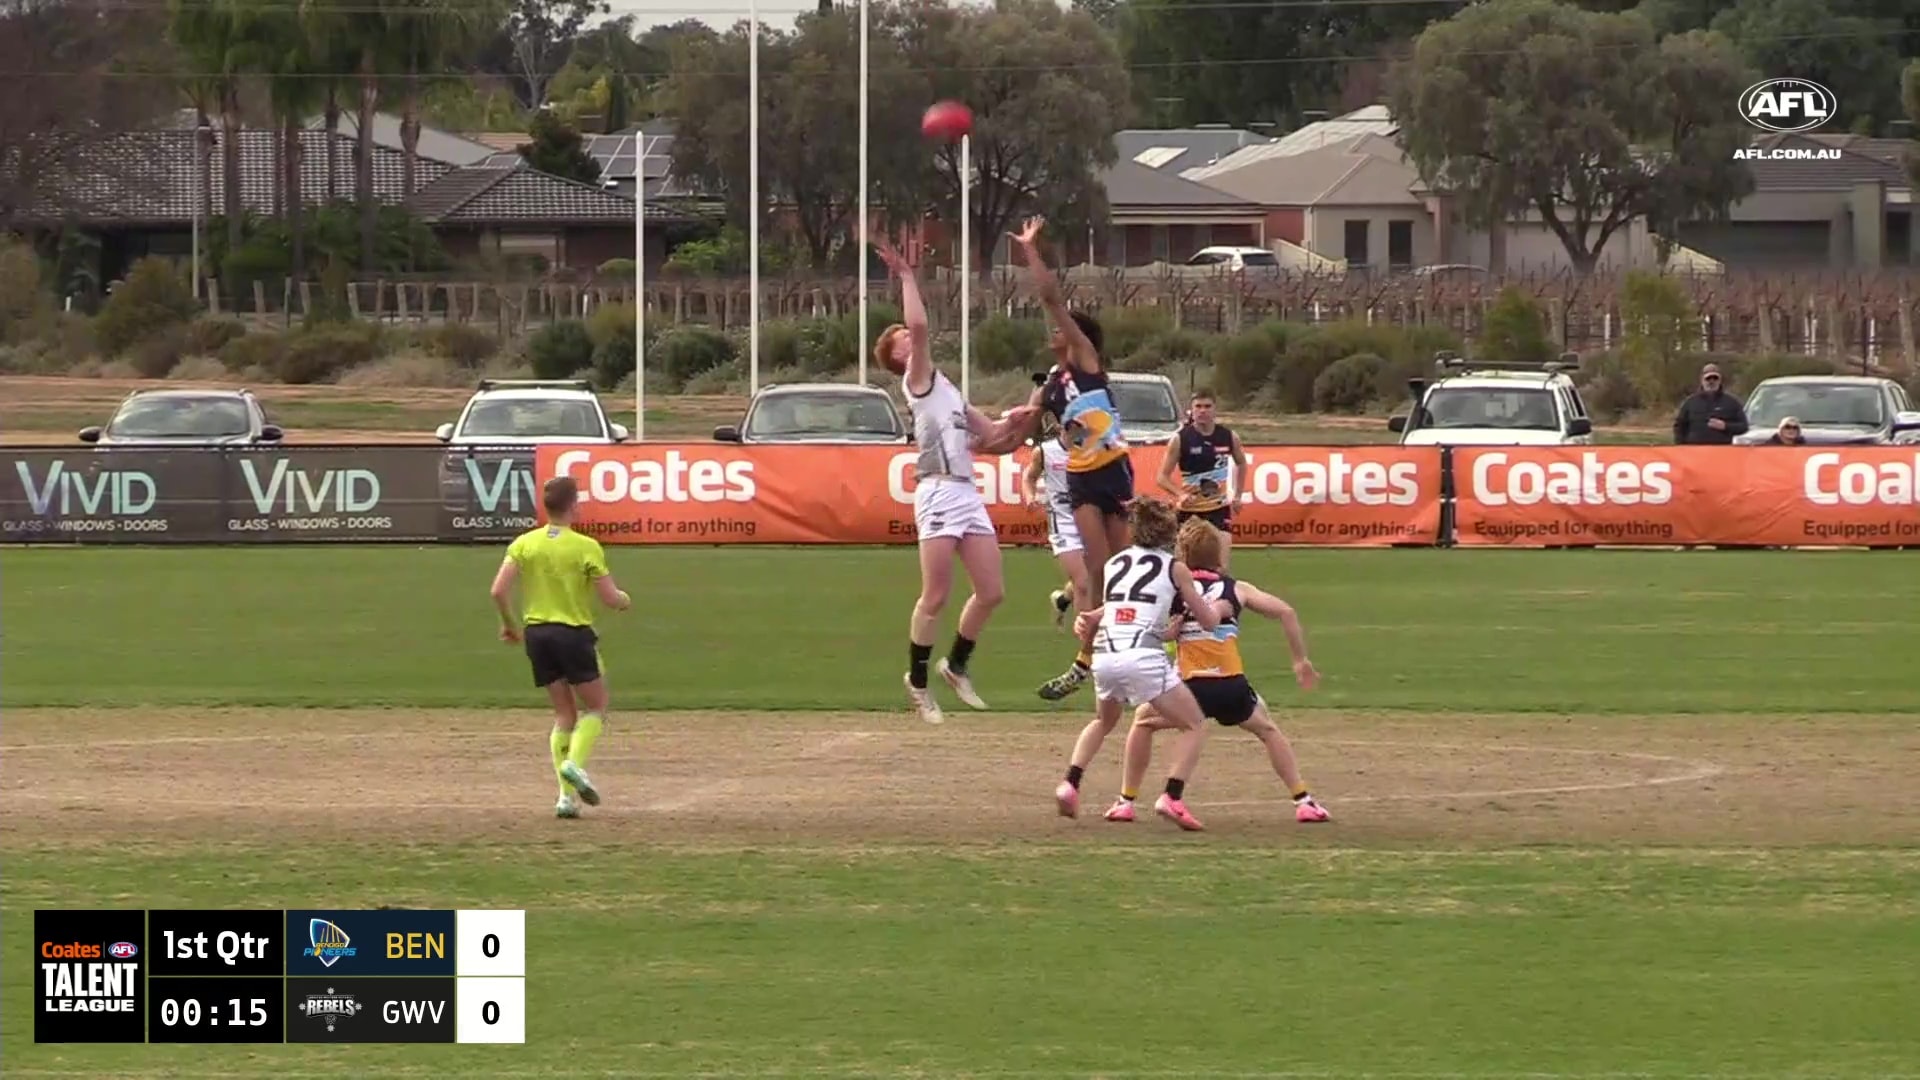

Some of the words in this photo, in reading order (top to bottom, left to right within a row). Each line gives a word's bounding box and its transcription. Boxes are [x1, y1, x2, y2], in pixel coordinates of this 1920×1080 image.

[555, 450, 756, 502] Coates
[1472, 452, 1672, 505] Coates
[1804, 452, 1920, 505] Coa
[3, 519, 43, 531] GLASS
[54, 519, 116, 531] WINDOWS
[124, 519, 168, 531] DOORS
[228, 518, 269, 530] GLASS
[278, 517, 339, 529] WINDOWS
[348, 517, 391, 529] DOORS
[452, 517, 493, 528] GLASS
[502, 517, 537, 528] WIND
[570, 518, 642, 535] quipped
[647, 518, 671, 533] for
[677, 518, 756, 535] anything
[1232, 520, 1304, 538] quipped
[1309, 520, 1334, 535] for
[1474, 520, 1559, 537] Equipped
[1565, 520, 1592, 535] for
[1594, 519, 1673, 537] anything
[1804, 520, 1890, 538] Equipped
[1105, 555, 1162, 604] 22
